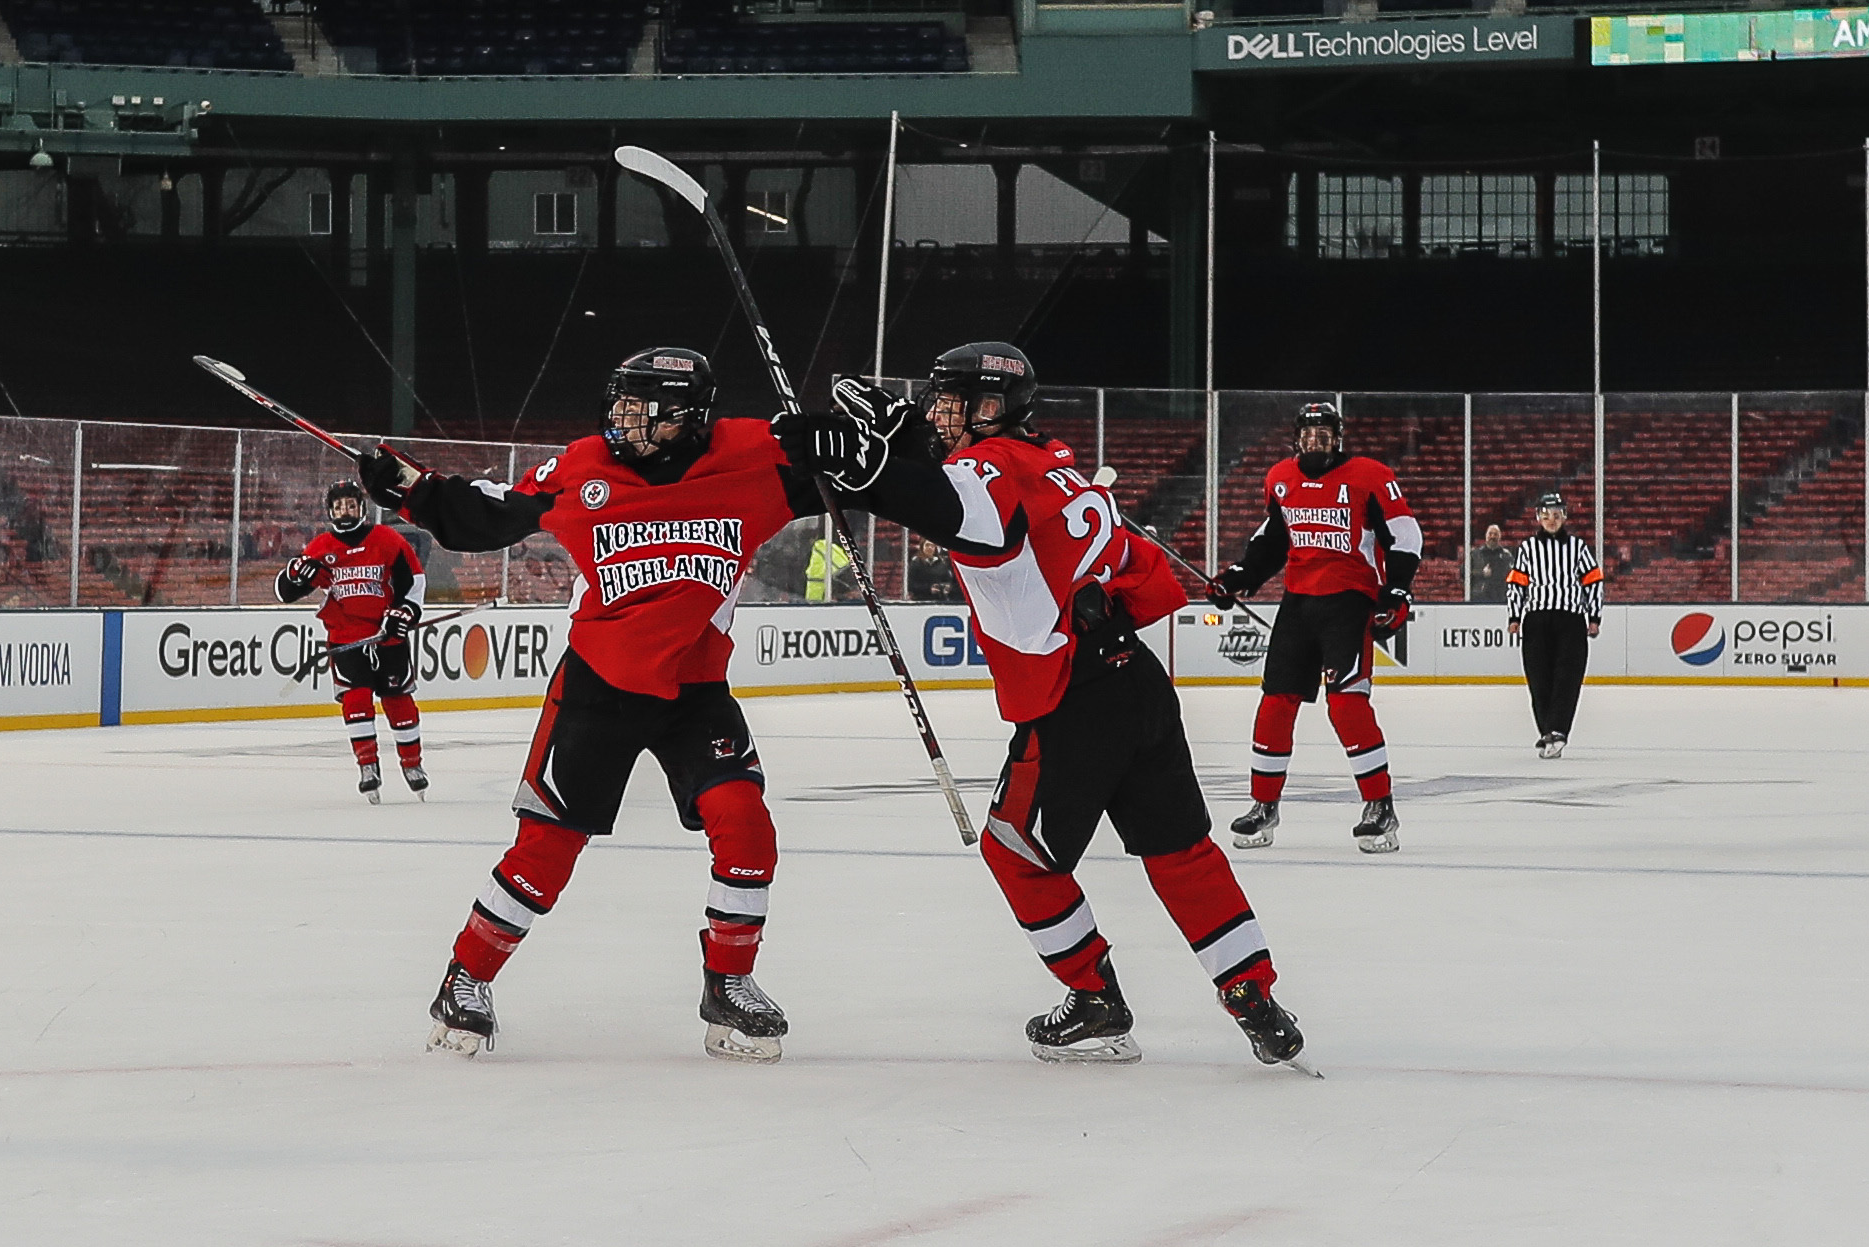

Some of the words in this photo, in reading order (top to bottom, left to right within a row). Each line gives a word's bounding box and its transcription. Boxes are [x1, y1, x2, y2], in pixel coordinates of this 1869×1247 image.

[1227, 33, 1304, 60] DELL
[1302, 28, 1466, 61] Technologies
[1473, 24, 1539, 53] Level
[1336, 484, 1349, 504] A
[593, 518, 743, 563] NORTHERN
[597, 555, 739, 606] HIGHLANDS
[782, 628, 885, 659] HONDA
[1219, 633, 1268, 654] NHL
[1443, 628, 1480, 648] LET'S
[1484, 628, 1503, 648] DO
[1733, 614, 1833, 650] pepsi
[19, 642, 72, 687] VODKA
[158, 621, 263, 679] Great
[1733, 653, 1777, 665] ZERO
[1780, 653, 1837, 666] SUGAR
[512, 873, 544, 898] CCM
[730, 866, 765, 877] CCM
